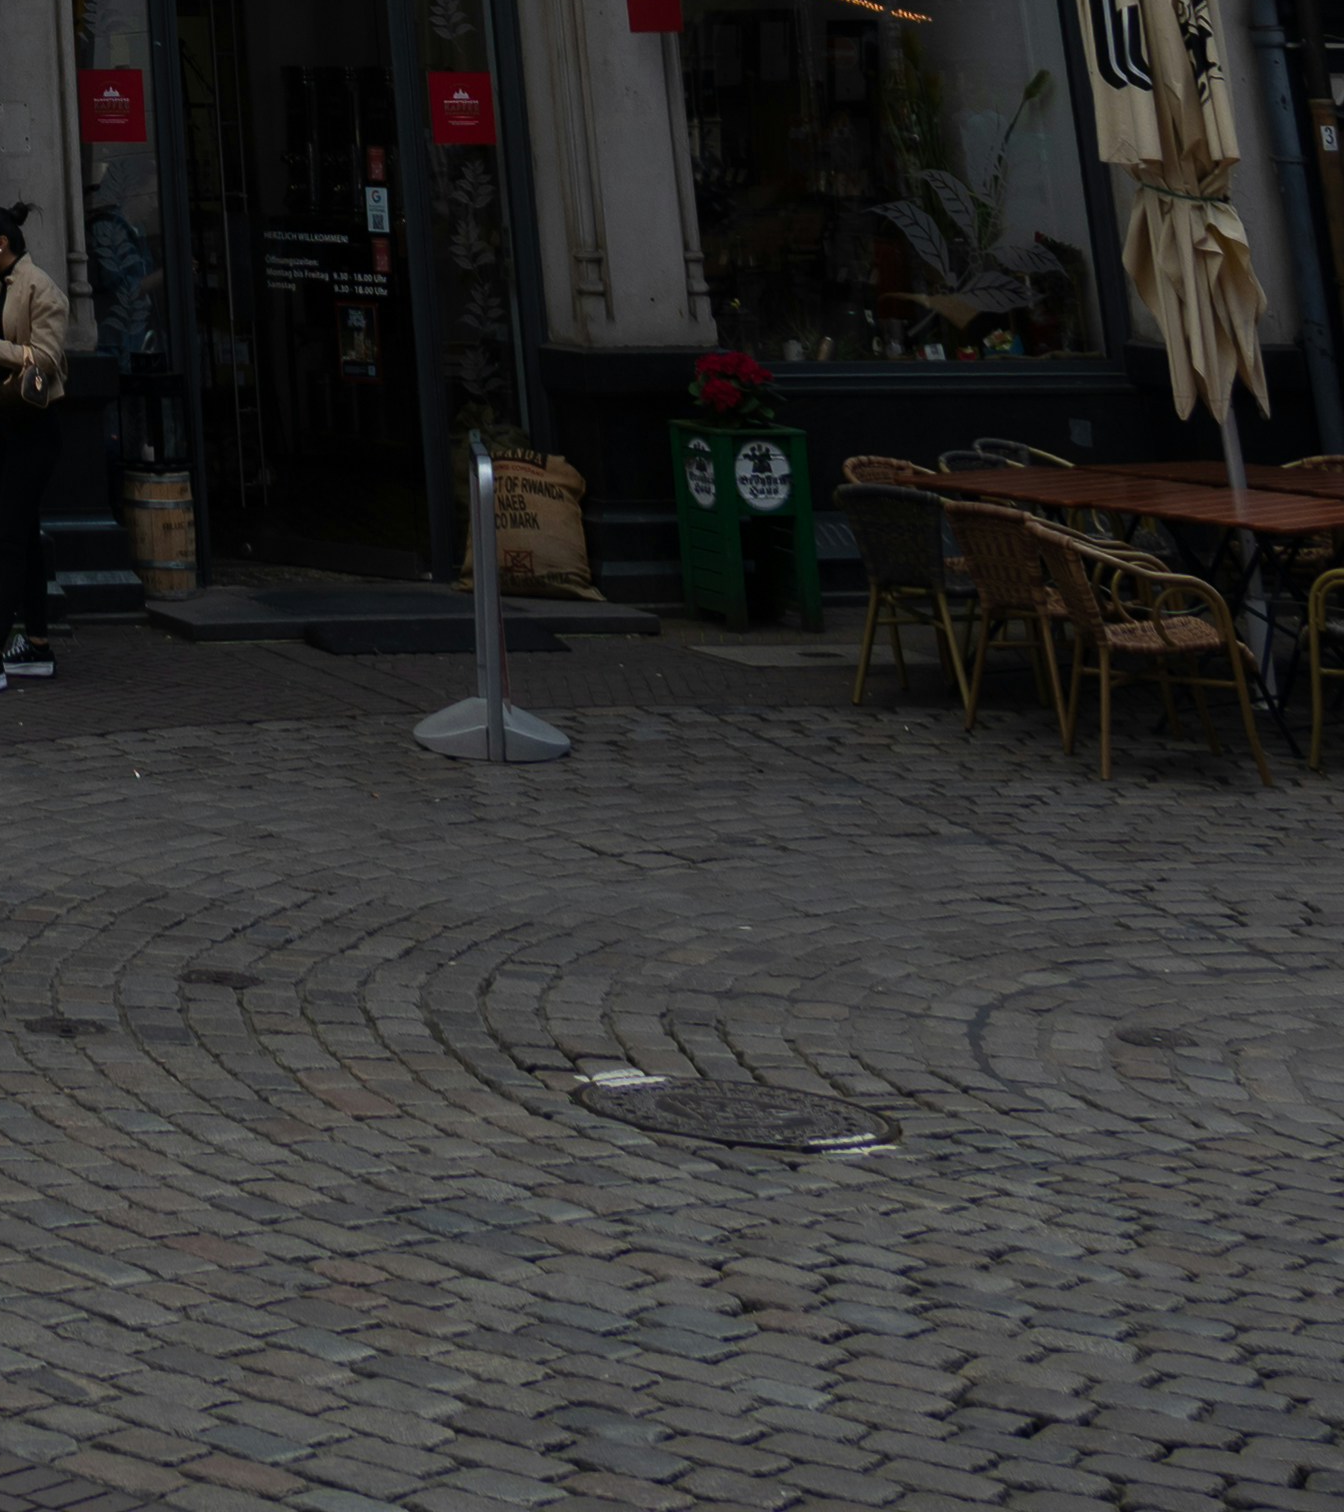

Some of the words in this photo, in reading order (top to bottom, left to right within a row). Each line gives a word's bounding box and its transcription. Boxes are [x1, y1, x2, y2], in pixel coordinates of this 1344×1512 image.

[505, 477, 519, 493] OF
[521, 477, 564, 502] RWANDA
[498, 494, 526, 510] NAEB
[512, 512, 540, 530] MARK
